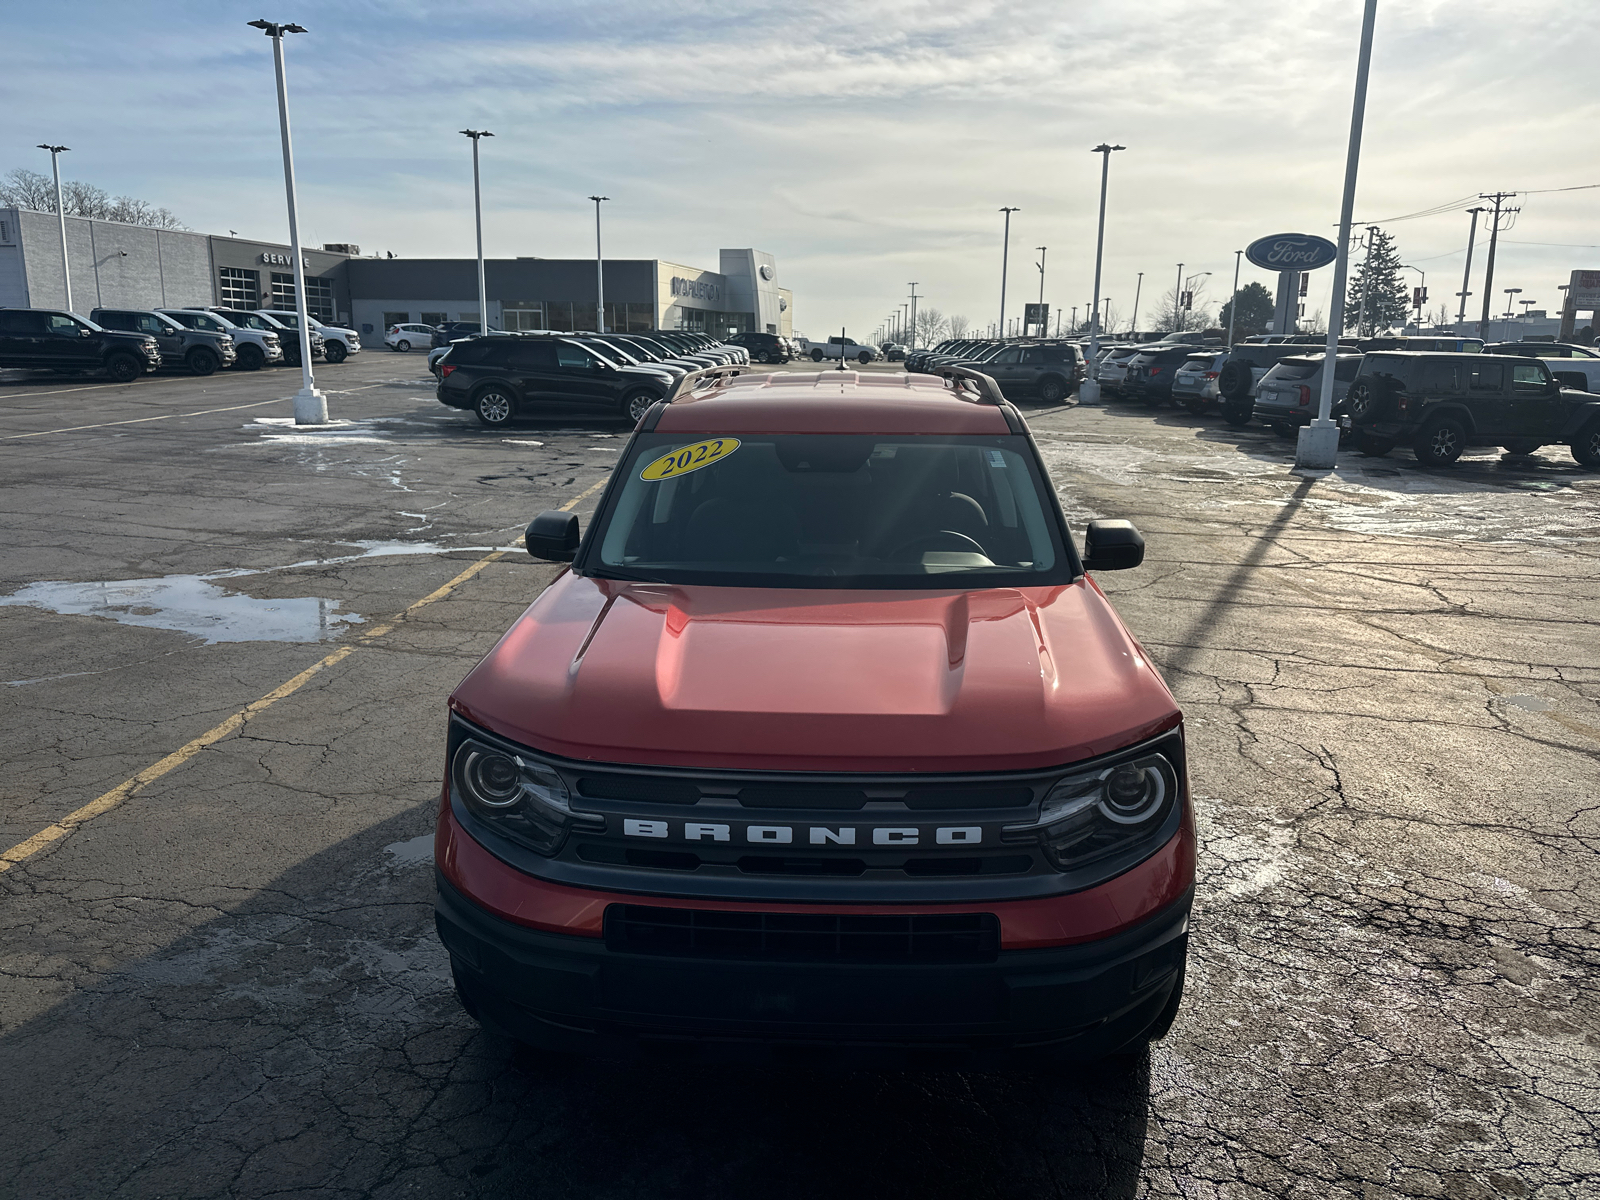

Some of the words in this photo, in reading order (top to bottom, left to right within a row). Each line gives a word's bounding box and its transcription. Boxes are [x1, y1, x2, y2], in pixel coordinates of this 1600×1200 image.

[263, 252, 310, 268] SERVE
[1267, 240, 1321, 263] Ford
[660, 440, 724, 476] 2022
[623, 818, 983, 846] BRONCO
